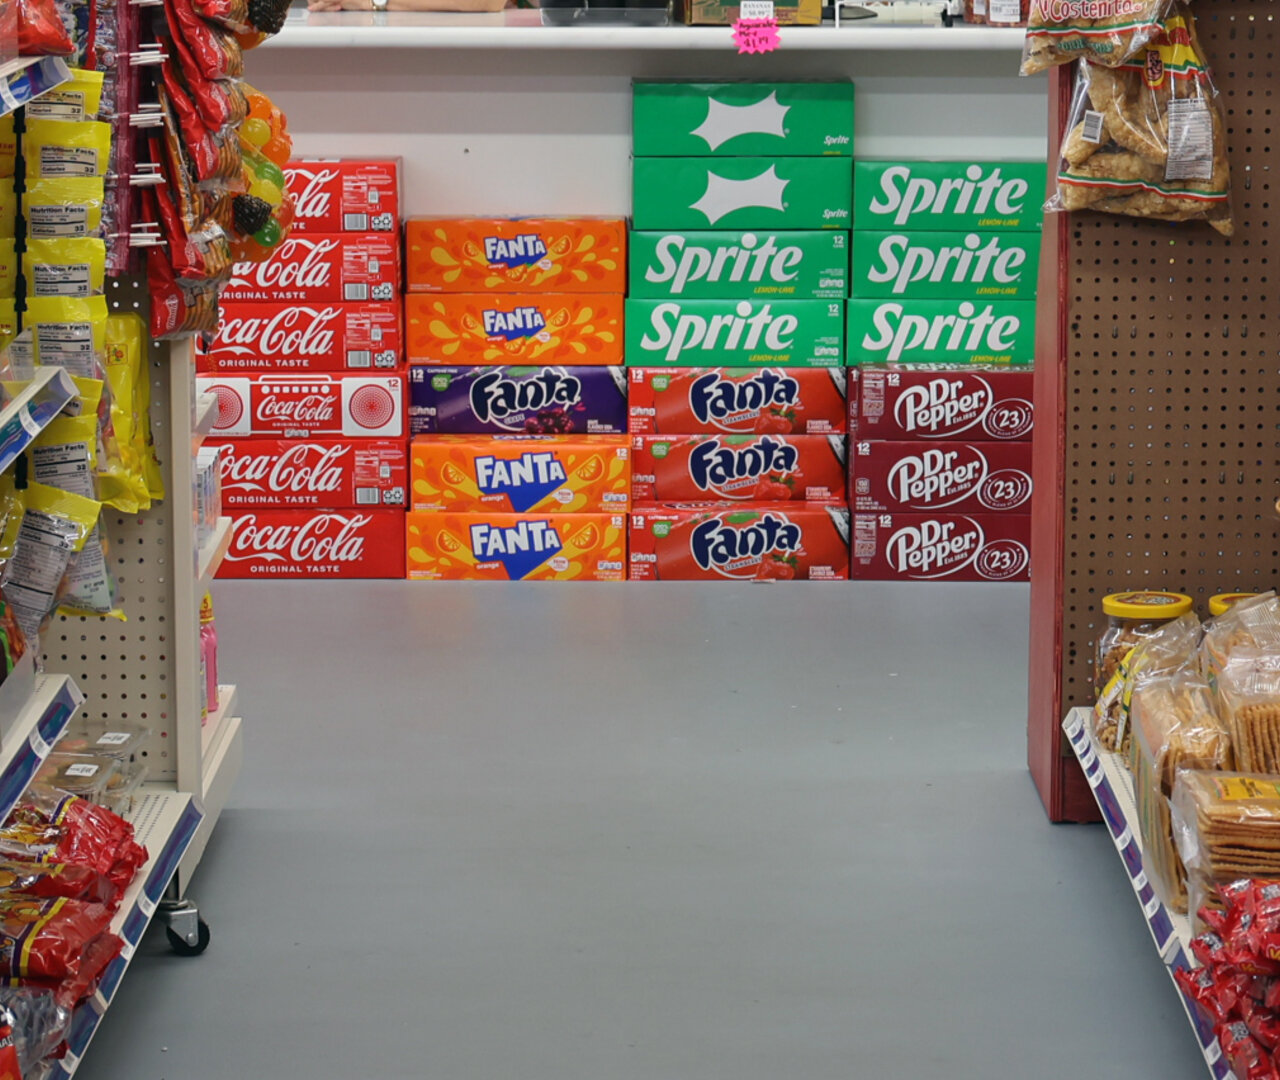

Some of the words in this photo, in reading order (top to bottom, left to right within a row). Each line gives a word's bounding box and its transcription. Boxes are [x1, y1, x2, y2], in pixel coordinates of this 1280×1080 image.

[869, 164, 1029, 226] Sprite
[821, 207, 849, 219] Sprite
[977, 218, 1020, 226] LEMON-LIME
[485, 234, 546, 260] FANTA
[832, 235, 844, 245] 12
[644, 232, 804, 294] Sprite
[867, 232, 1027, 294] Sprite
[274, 291, 306, 300] TASTE
[753, 286, 795, 294] LEMON-LIME
[975, 286, 1018, 295] LEMON-LIME
[483, 306, 545, 332] FANTA
[827, 304, 839, 313] 12
[639, 301, 798, 361] Sprite
[861, 301, 1020, 361] Sprite
[218, 358, 272, 367] ORIGINAL
[275, 358, 309, 367] TASTE
[749, 354, 790, 362] LEMON-LIME
[970, 355, 1011, 363] LEMON-LIME
[887, 374, 900, 383] 12
[929, 378, 963, 403] Dr
[471, 366, 581, 424] Fanta
[689, 369, 799, 424] Fanta
[257, 395, 338, 421] Coca-Cola
[900, 385, 985, 432] Pepper
[999, 410, 1020, 428] 23
[857, 443, 870, 452] 12
[475, 452, 567, 489] FANTA
[689, 437, 798, 491] Fanta
[923, 449, 958, 474] Dr
[894, 456, 980, 503] Pepper
[994, 481, 1015, 499] 23
[228, 495, 278, 504] ORIGINAL
[283, 495, 319, 504] TASTE
[611, 517, 623, 525] 12
[879, 515, 892, 524] 12
[471, 521, 562, 556] FANTA
[691, 515, 802, 569] Fanta
[920, 520, 955, 545] Dr
[892, 527, 977, 572] Pepper
[990, 551, 1011, 568] 23
[250, 565, 303, 574] ORIGINAL
[305, 565, 340, 574] TASTE
